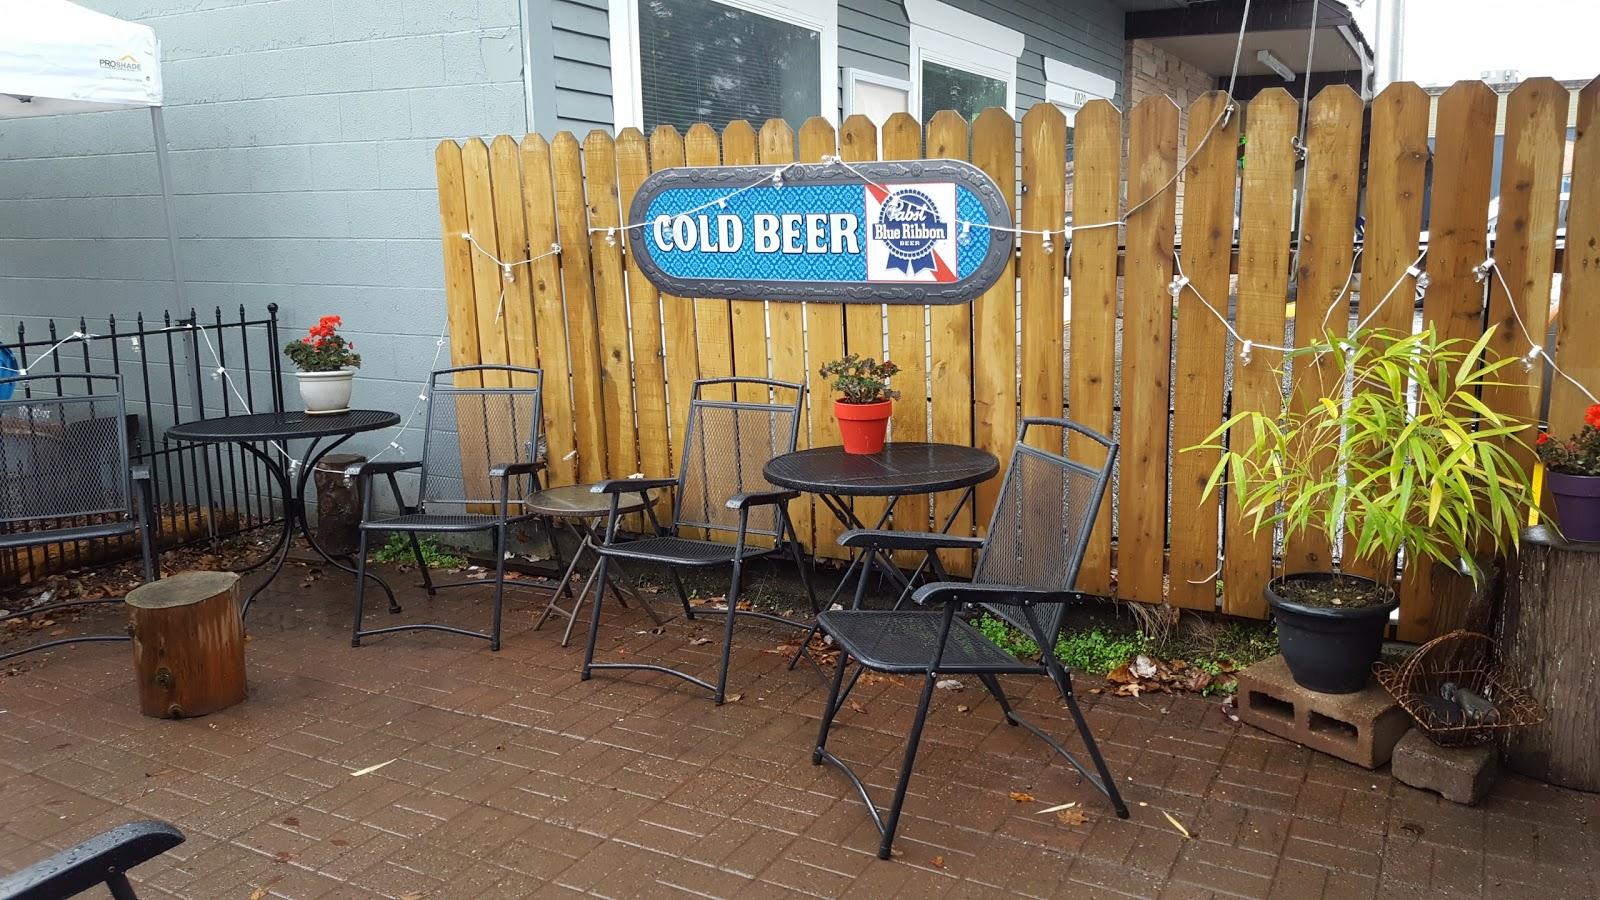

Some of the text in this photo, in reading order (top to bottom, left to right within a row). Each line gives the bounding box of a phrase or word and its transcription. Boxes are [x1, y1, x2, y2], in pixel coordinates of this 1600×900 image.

[99, 59, 142, 71] PROSHADE
[887, 201, 928, 222] Pabst
[653, 213, 861, 254] COLD BEER
[874, 223, 946, 240] Blue Ribbon
